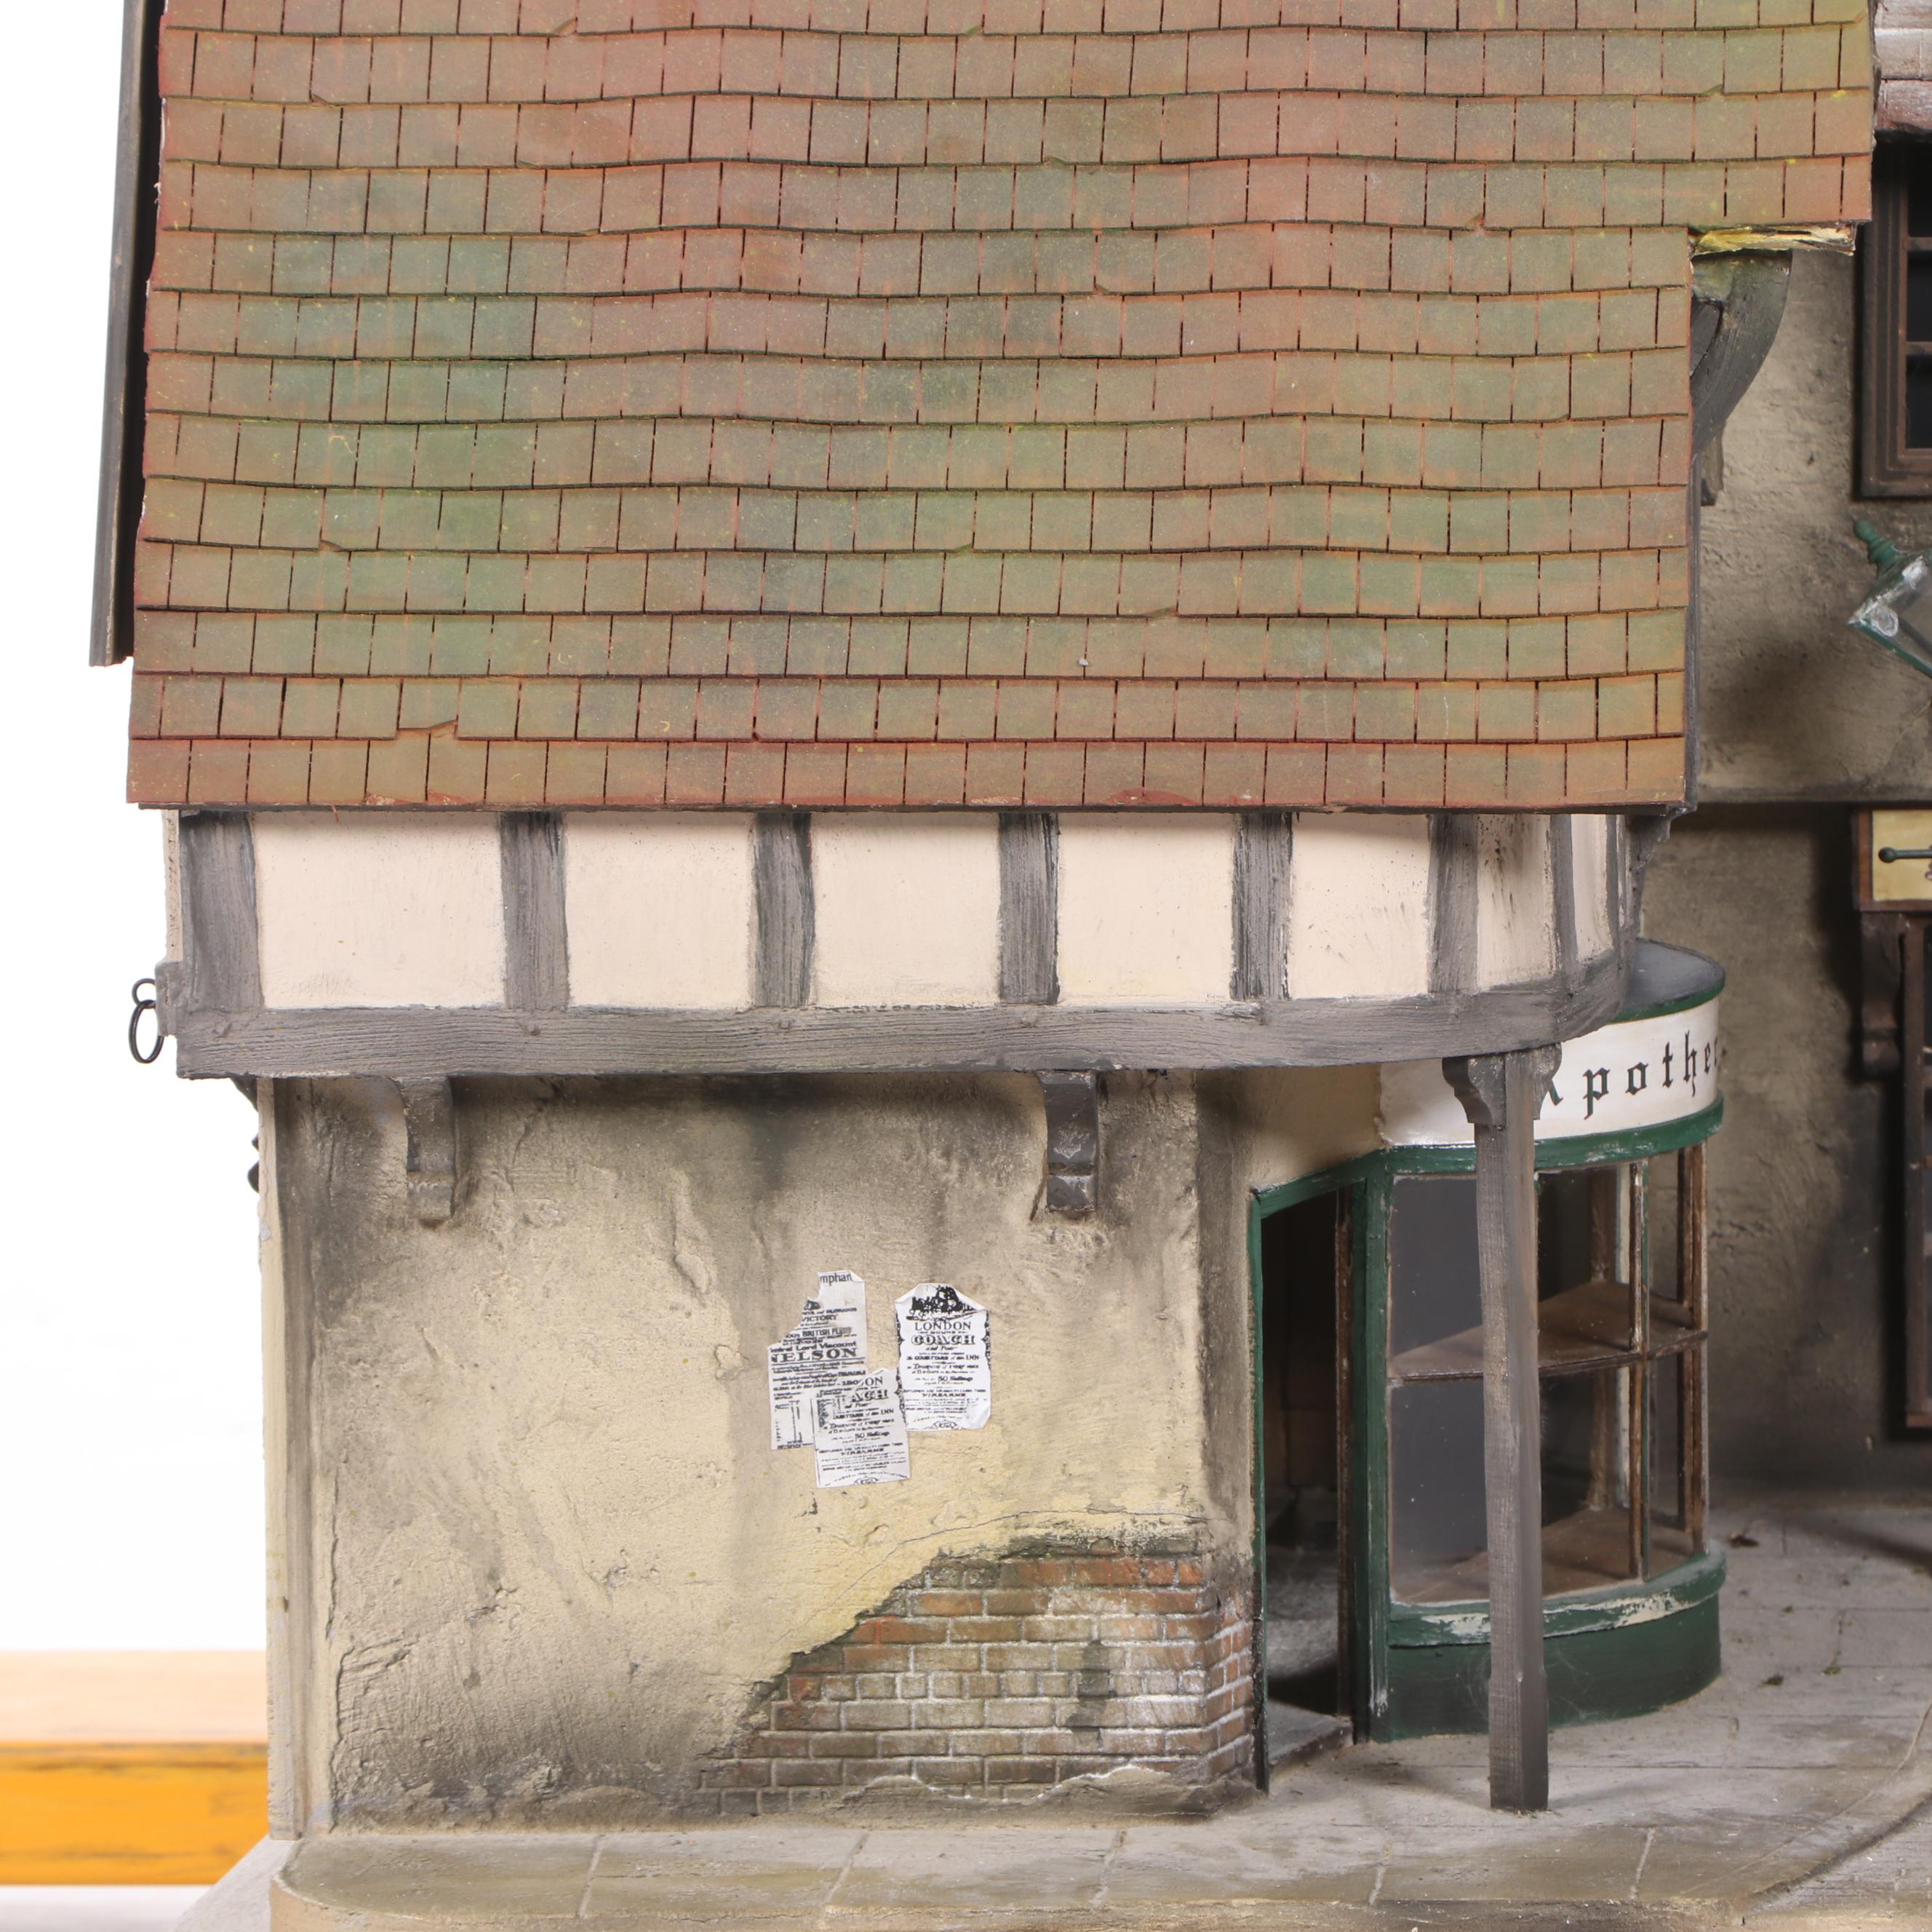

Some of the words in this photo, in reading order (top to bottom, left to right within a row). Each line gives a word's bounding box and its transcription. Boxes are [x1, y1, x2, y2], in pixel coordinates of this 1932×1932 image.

[915, 1322, 971, 1331] LONDON
[911, 1334, 975, 1345] COACH
[797, 1344, 817, 1352] Lord
[819, 1341, 857, 1349] Viscount
[771, 1348, 858, 1362] NELSON
[860, 1376, 883, 1386] ON
